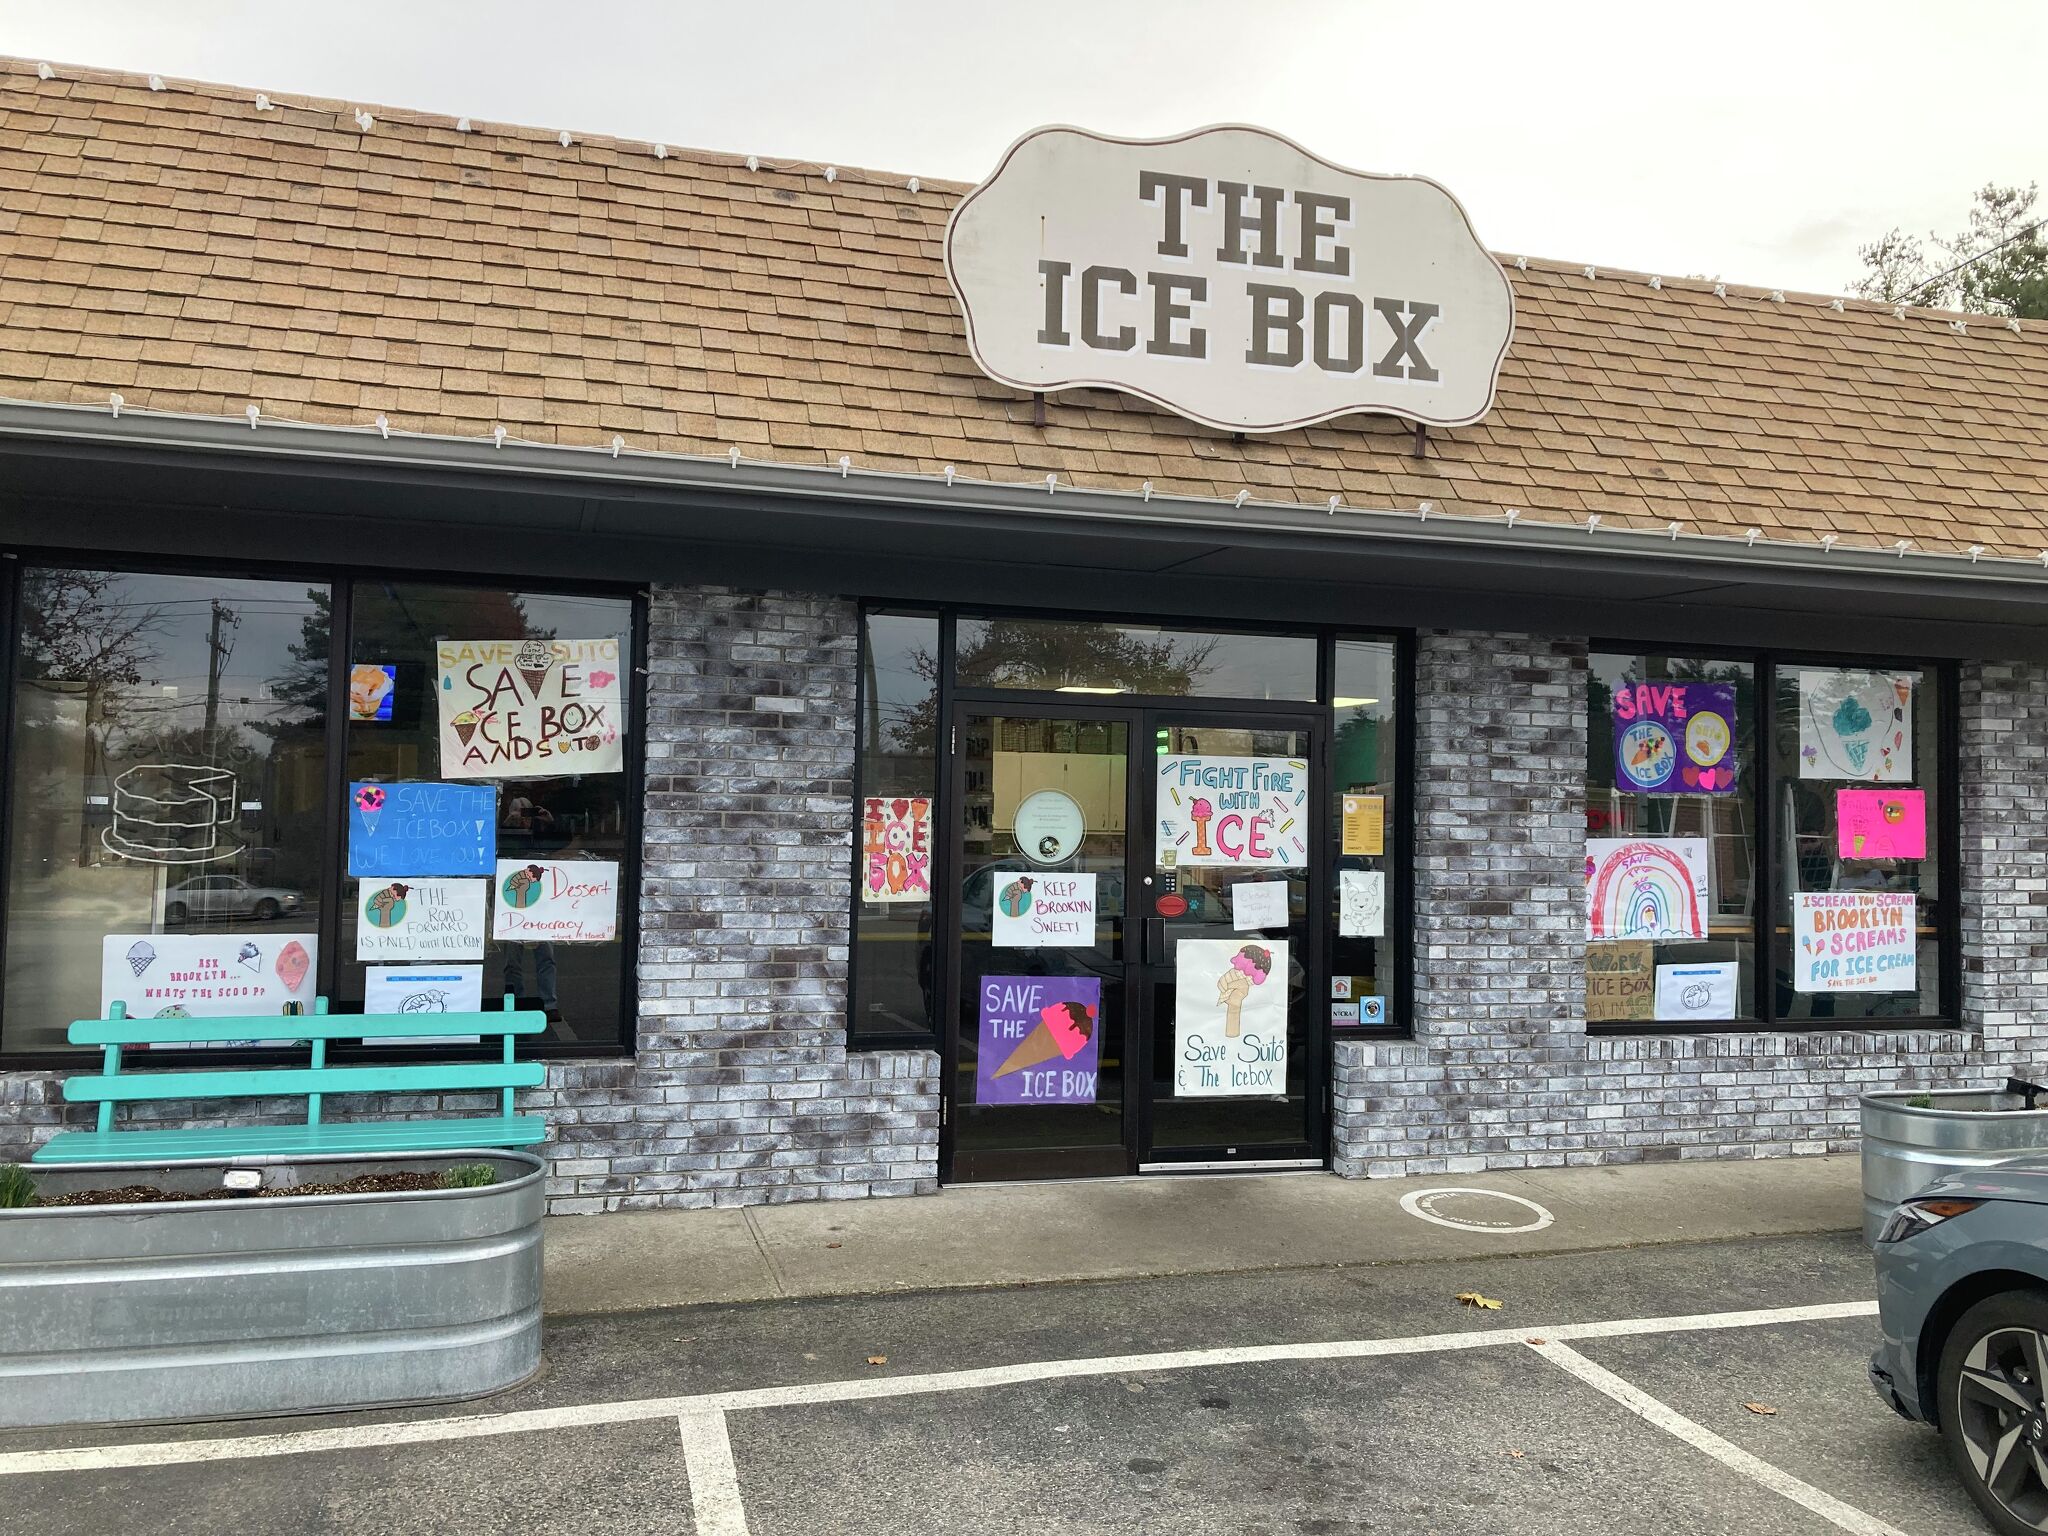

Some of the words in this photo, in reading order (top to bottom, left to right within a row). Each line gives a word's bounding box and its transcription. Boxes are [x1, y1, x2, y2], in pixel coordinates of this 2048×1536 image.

[1139, 169, 1354, 277] THE
[1037, 259, 1209, 361] ICE
[1245, 281, 1441, 383] BOX
[439, 642, 514, 669] SAVE
[1616, 683, 1688, 720] SAVE
[541, 701, 606, 740] BOX
[1629, 727, 1653, 742] THE
[1179, 759, 1249, 790] FIGHT
[1252, 762, 1294, 793] FIRE
[1635, 766, 1652, 779] ICE
[1654, 752, 1674, 777] BOX
[397, 787, 449, 813] SAVE
[455, 790, 495, 814] THE
[1218, 791, 1260, 810] WITH
[864, 821, 928, 853] ICE
[1190, 803, 1275, 862] ICE
[355, 844, 390, 869] WE
[400, 848, 440, 866] LOVE
[1622, 853, 1651, 870] SAVE
[549, 866, 612, 900] Dessert
[1042, 880, 1078, 897] KEEP
[416, 888, 449, 906] THE
[1803, 895, 1810, 907] I
[1810, 895, 1856, 908] SCREAM
[1858, 895, 1875, 906] YOU
[1876, 894, 1914, 908] SCREAM
[428, 907, 464, 923] ROAD
[1030, 917, 1080, 936] SWEET!
[1813, 906, 1903, 933] BROOKLYN
[407, 921, 469, 935] FORWARD
[360, 935, 374, 948] IS
[378, 936, 417, 950] PAVED
[1830, 928, 1907, 955] SCREAMS
[198, 958, 220, 968] ASK
[1587, 951, 1648, 973] WORK
[1811, 958, 1840, 981] FOR
[1845, 955, 1874, 976] ICE
[1876, 953, 1915, 972] CREAM
[192, 987, 212, 999] THE
[1592, 976, 1615, 996] ICE
[1619, 973, 1652, 996] BOX
[1827, 979, 1843, 988] SAVE
[985, 983, 1044, 1014] SAVE
[1586, 1000, 1606, 1019] HEN
[988, 1019, 1027, 1039] THE
[1184, 1034, 1227, 1062] Save
[1020, 1070, 1057, 1098] ICE
[1062, 1070, 1098, 1099] BOX
[1193, 1065, 1220, 1088] The
[1231, 1064, 1273, 1088] Icebox
